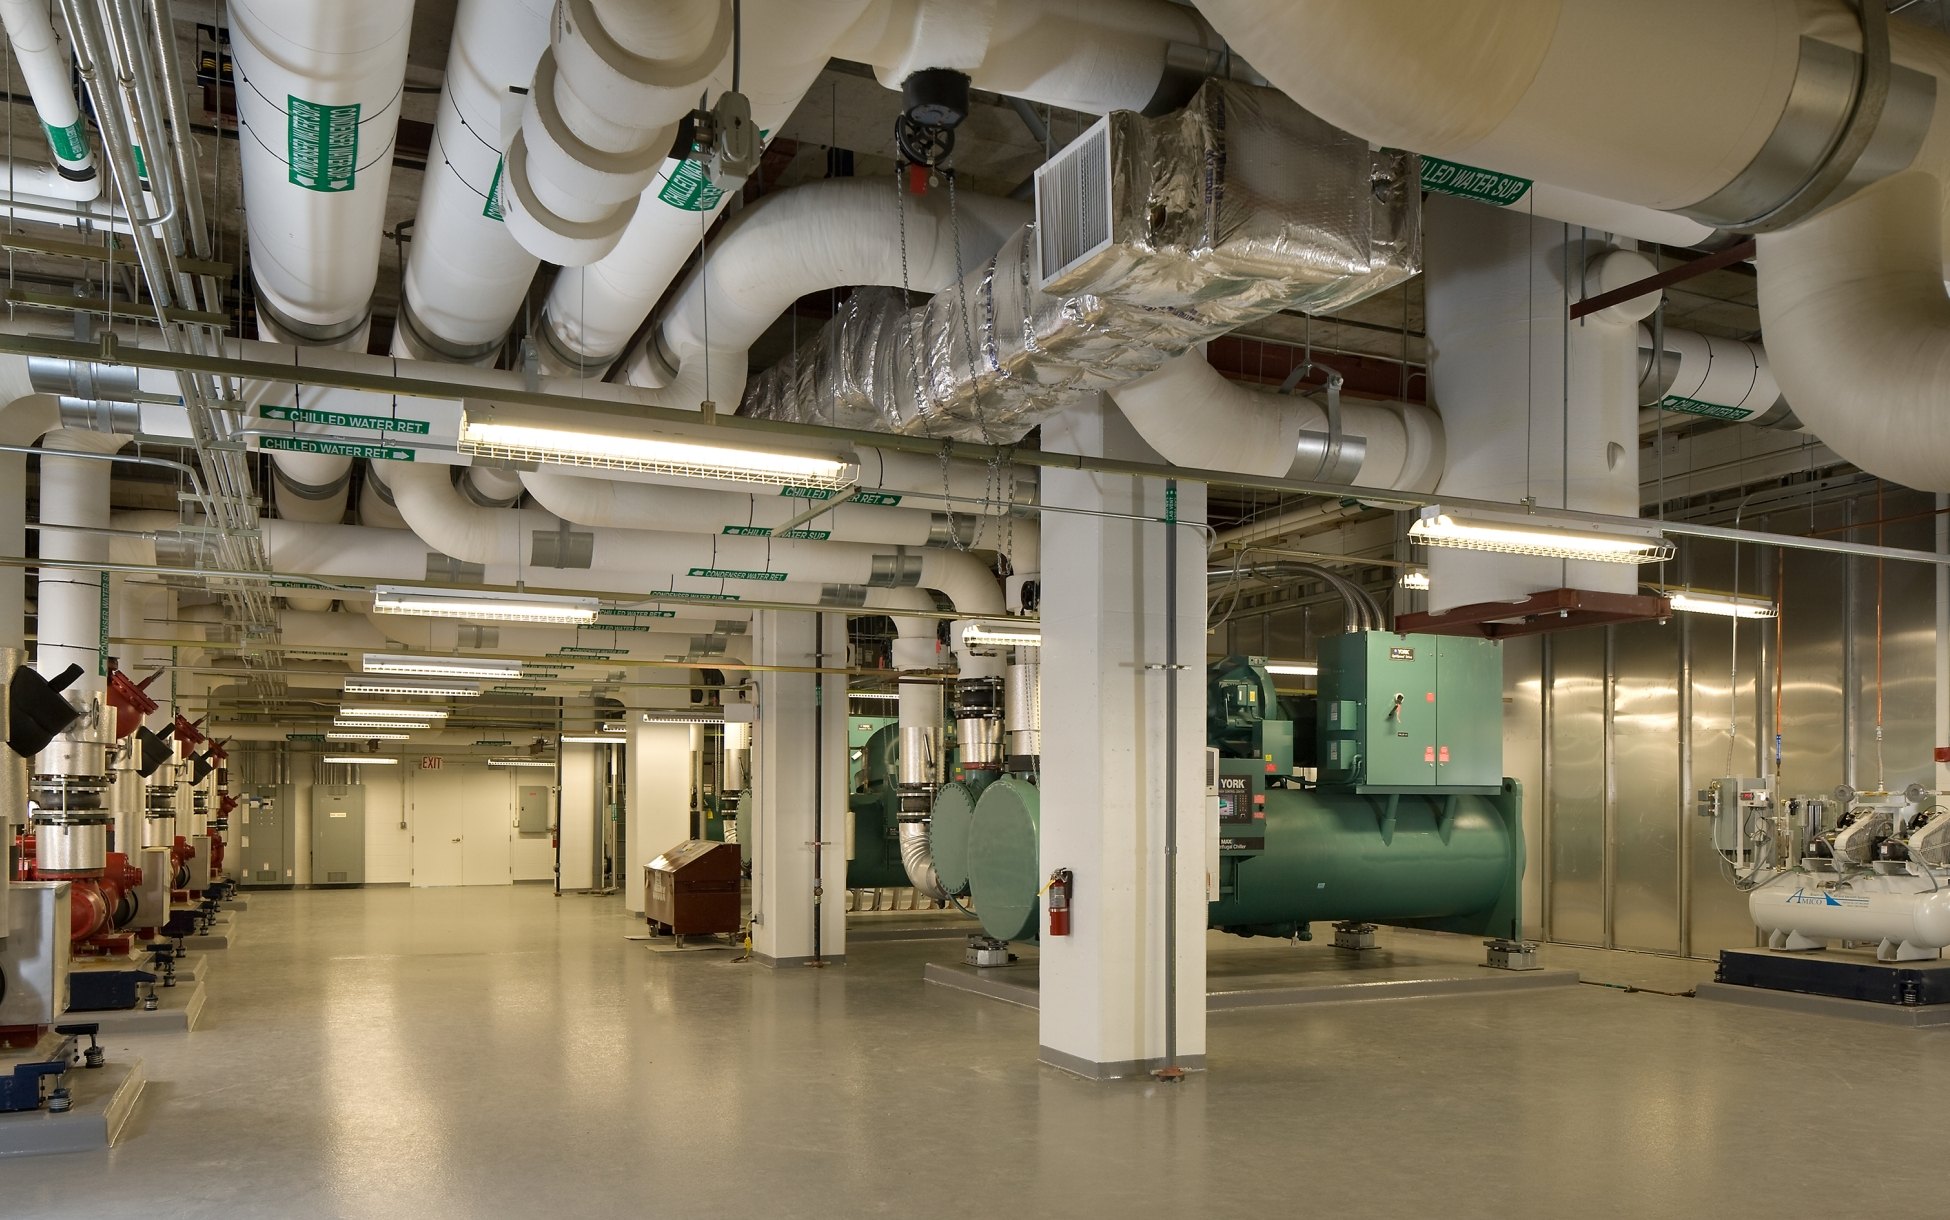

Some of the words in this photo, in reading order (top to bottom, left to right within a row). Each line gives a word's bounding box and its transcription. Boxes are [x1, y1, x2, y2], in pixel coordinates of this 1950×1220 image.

[293, 115, 320, 142] WATER
[328, 145, 354, 168] WATER
[663, 175, 698, 206] CHILLED
[1448, 169, 1499, 194] WATER
[1491, 178, 1524, 200] SUP.
[290, 410, 346, 426] CHILLED
[349, 417, 394, 431] WATER
[397, 421, 424, 434] RET.
[265, 438, 317, 453] CHILLED
[320, 443, 362, 457] WATER
[365, 448, 389, 459] RET.
[785, 486, 827, 499] CHILLED
[860, 494, 882, 504] RET.
[741, 528, 772, 537] CHILLE
[782, 530, 807, 539] ATER
[705, 570, 747, 579] CONDENSER
[422, 756, 442, 769] EXIT
[1220, 778, 1245, 789] YORK
